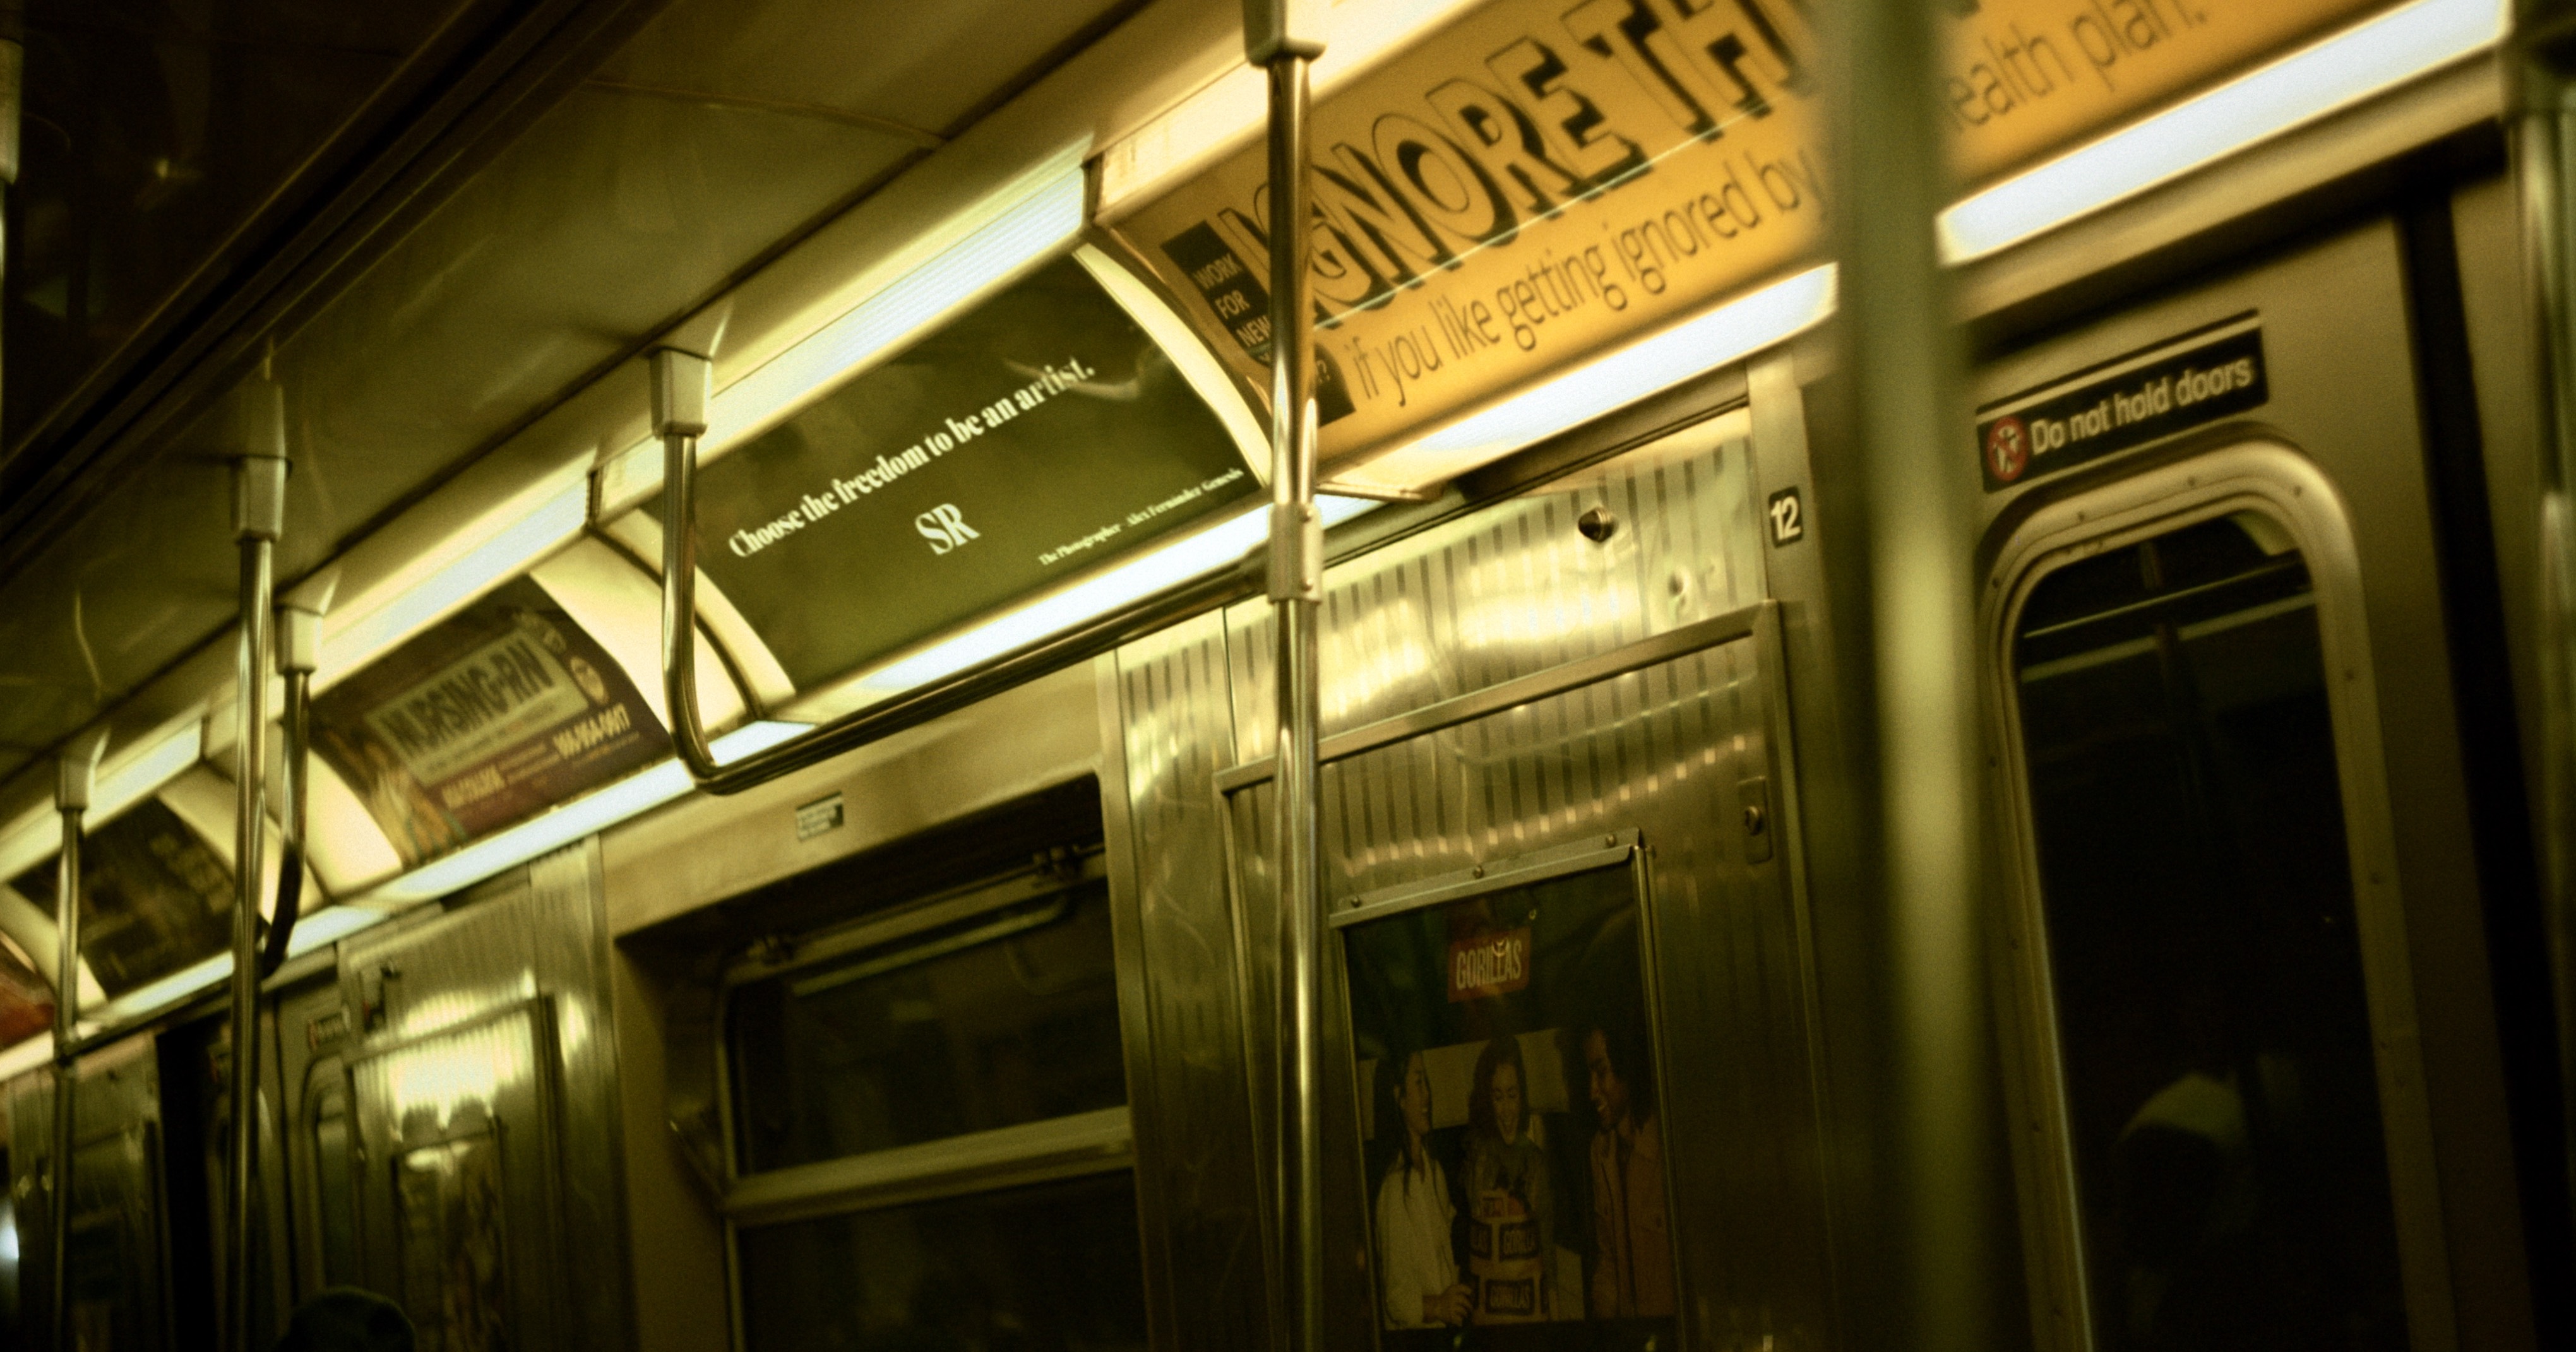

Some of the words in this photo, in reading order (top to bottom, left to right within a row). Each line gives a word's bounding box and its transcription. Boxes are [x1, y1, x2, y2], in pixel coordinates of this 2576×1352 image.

[1217, 34, 1652, 331] IGNORE
[1345, 335, 1380, 400] if
[1374, 325, 1443, 407] you
[1429, 288, 1501, 360] like
[1496, 242, 1629, 352] getting
[1602, 161, 1760, 296] ignored
[1947, 21, 2073, 126] ealth
[1192, 254, 1241, 290] WORK
[1214, 290, 1251, 319] FOR
[1236, 315, 1272, 347] NEW
[2030, 418, 2065, 456] Do
[2070, 400, 2111, 441] not
[2113, 377, 2171, 426] hold
[2176, 357, 2253, 406] doors
[729, 509, 806, 557] Choose
[799, 492, 840, 522] the
[831, 444, 931, 504] freedom
[923, 432, 955, 457] to
[945, 416, 985, 444] be
[981, 397, 1020, 429] an
[1013, 355, 1095, 411] artist.
[915, 503, 981, 555] SR
[1770, 495, 1801, 541] 12
[1456, 937, 1522, 991] GORILLAS
